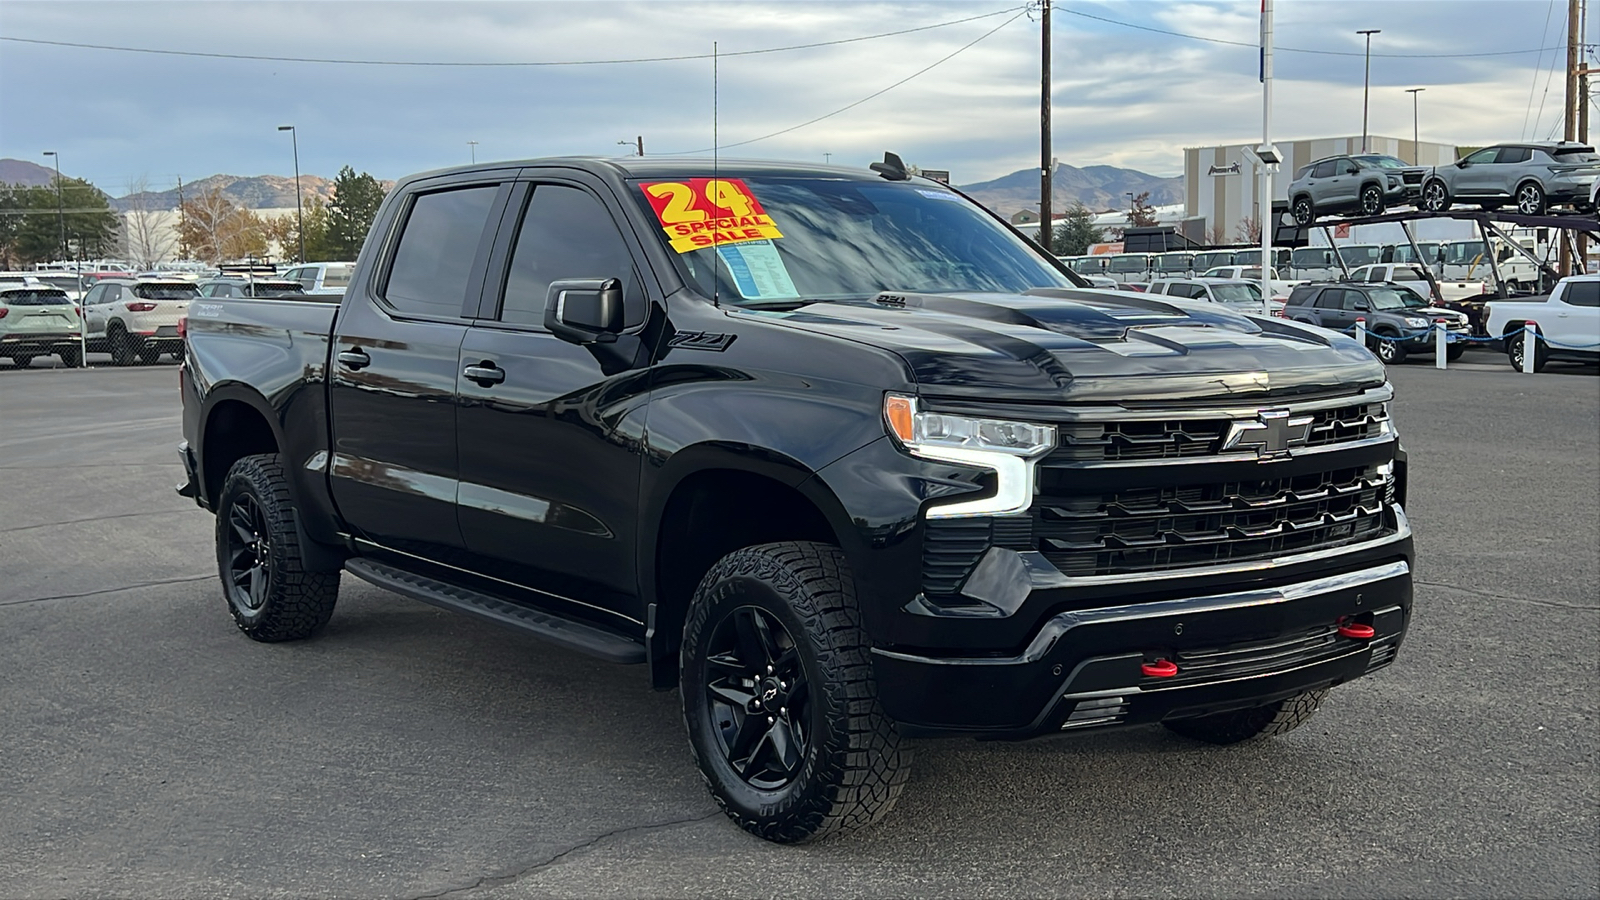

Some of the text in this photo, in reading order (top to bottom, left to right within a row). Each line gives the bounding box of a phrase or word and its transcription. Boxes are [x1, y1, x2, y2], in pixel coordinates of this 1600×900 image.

[647, 180, 754, 224] 24
[674, 216, 769, 236] SPECIAL
[690, 228, 763, 246] SALE
